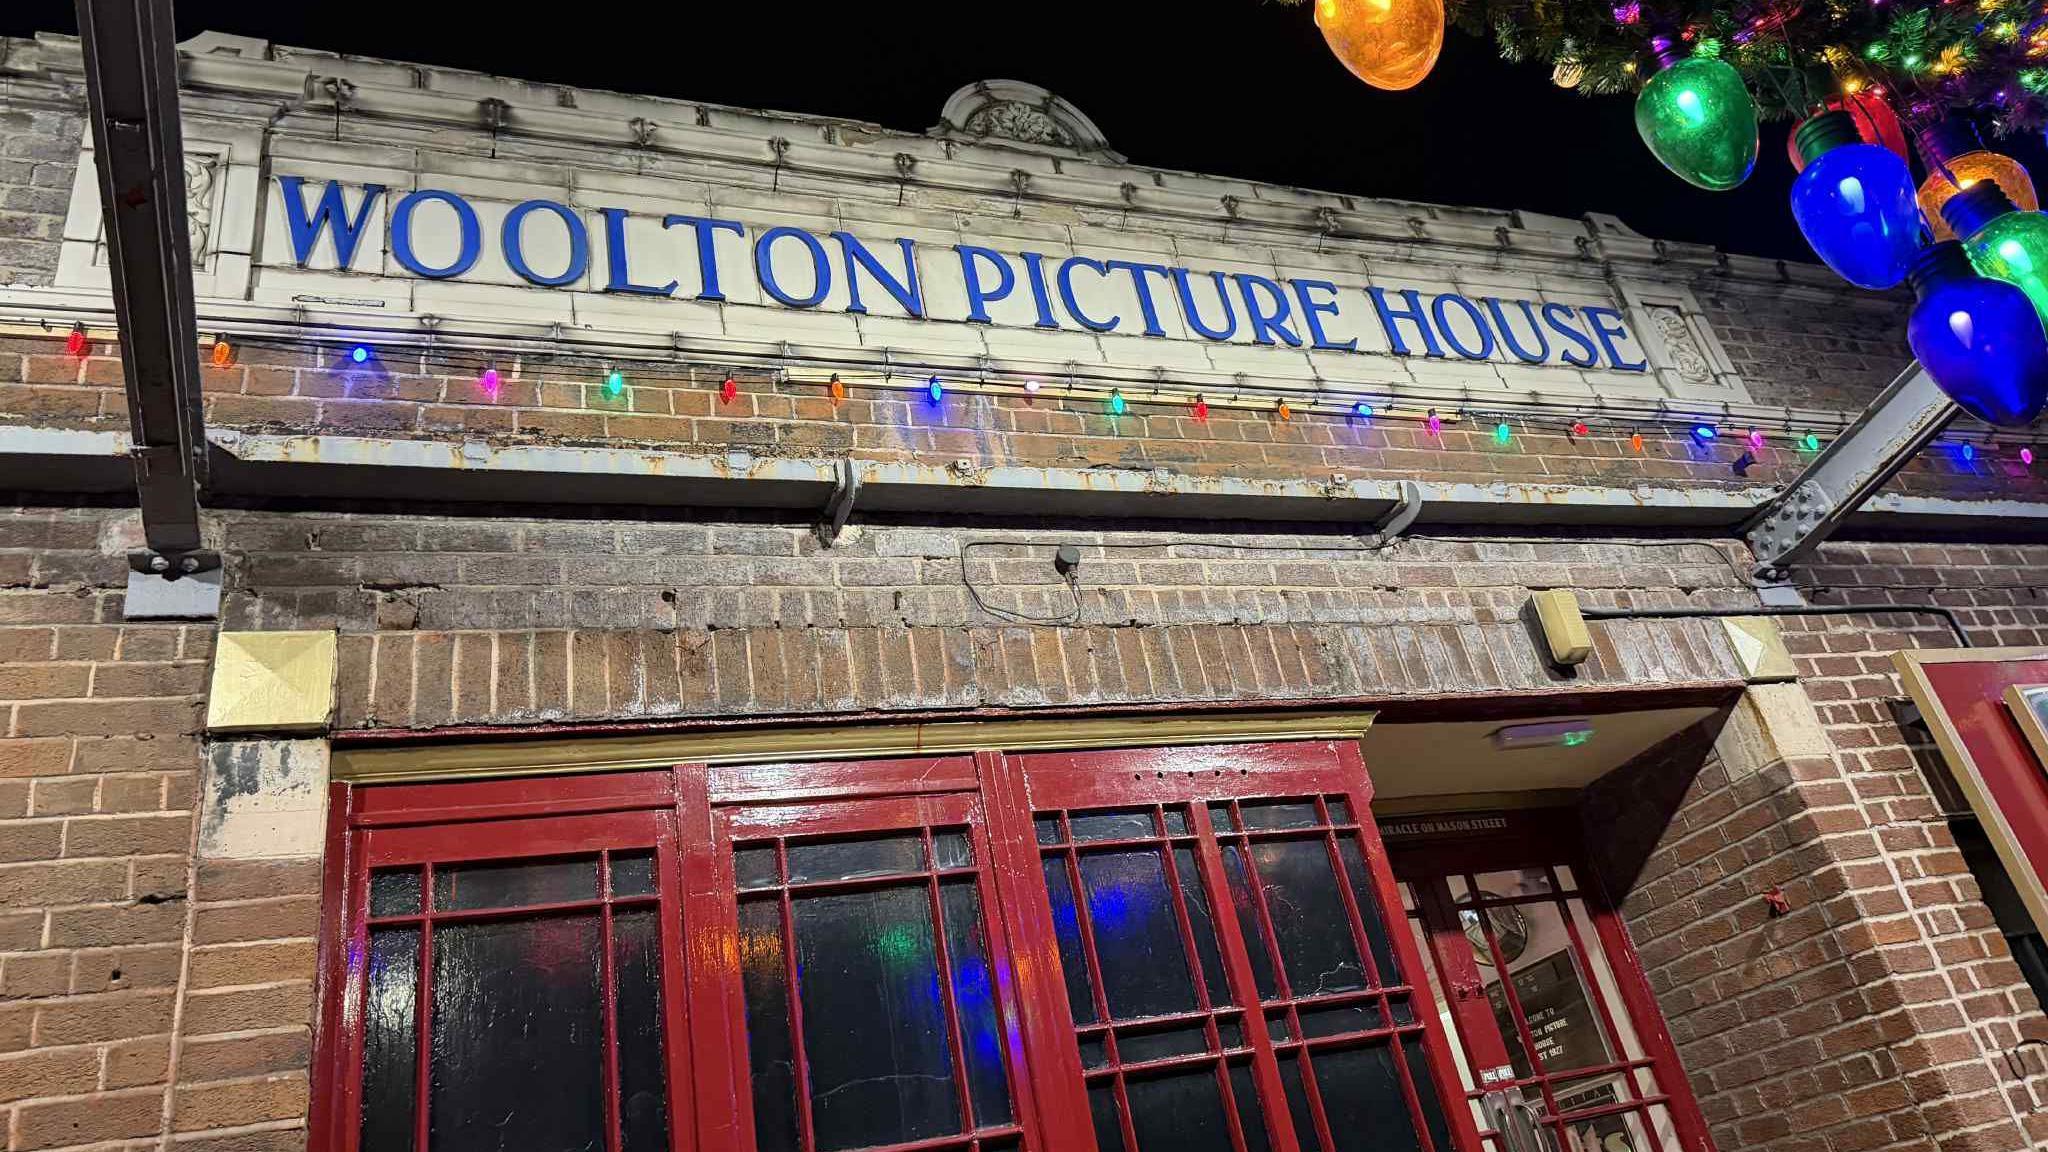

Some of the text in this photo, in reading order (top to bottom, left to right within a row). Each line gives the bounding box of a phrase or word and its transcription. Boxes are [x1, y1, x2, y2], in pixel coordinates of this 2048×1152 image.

[279, 175, 1647, 373] WOOLTON PICTURE HOUSE
